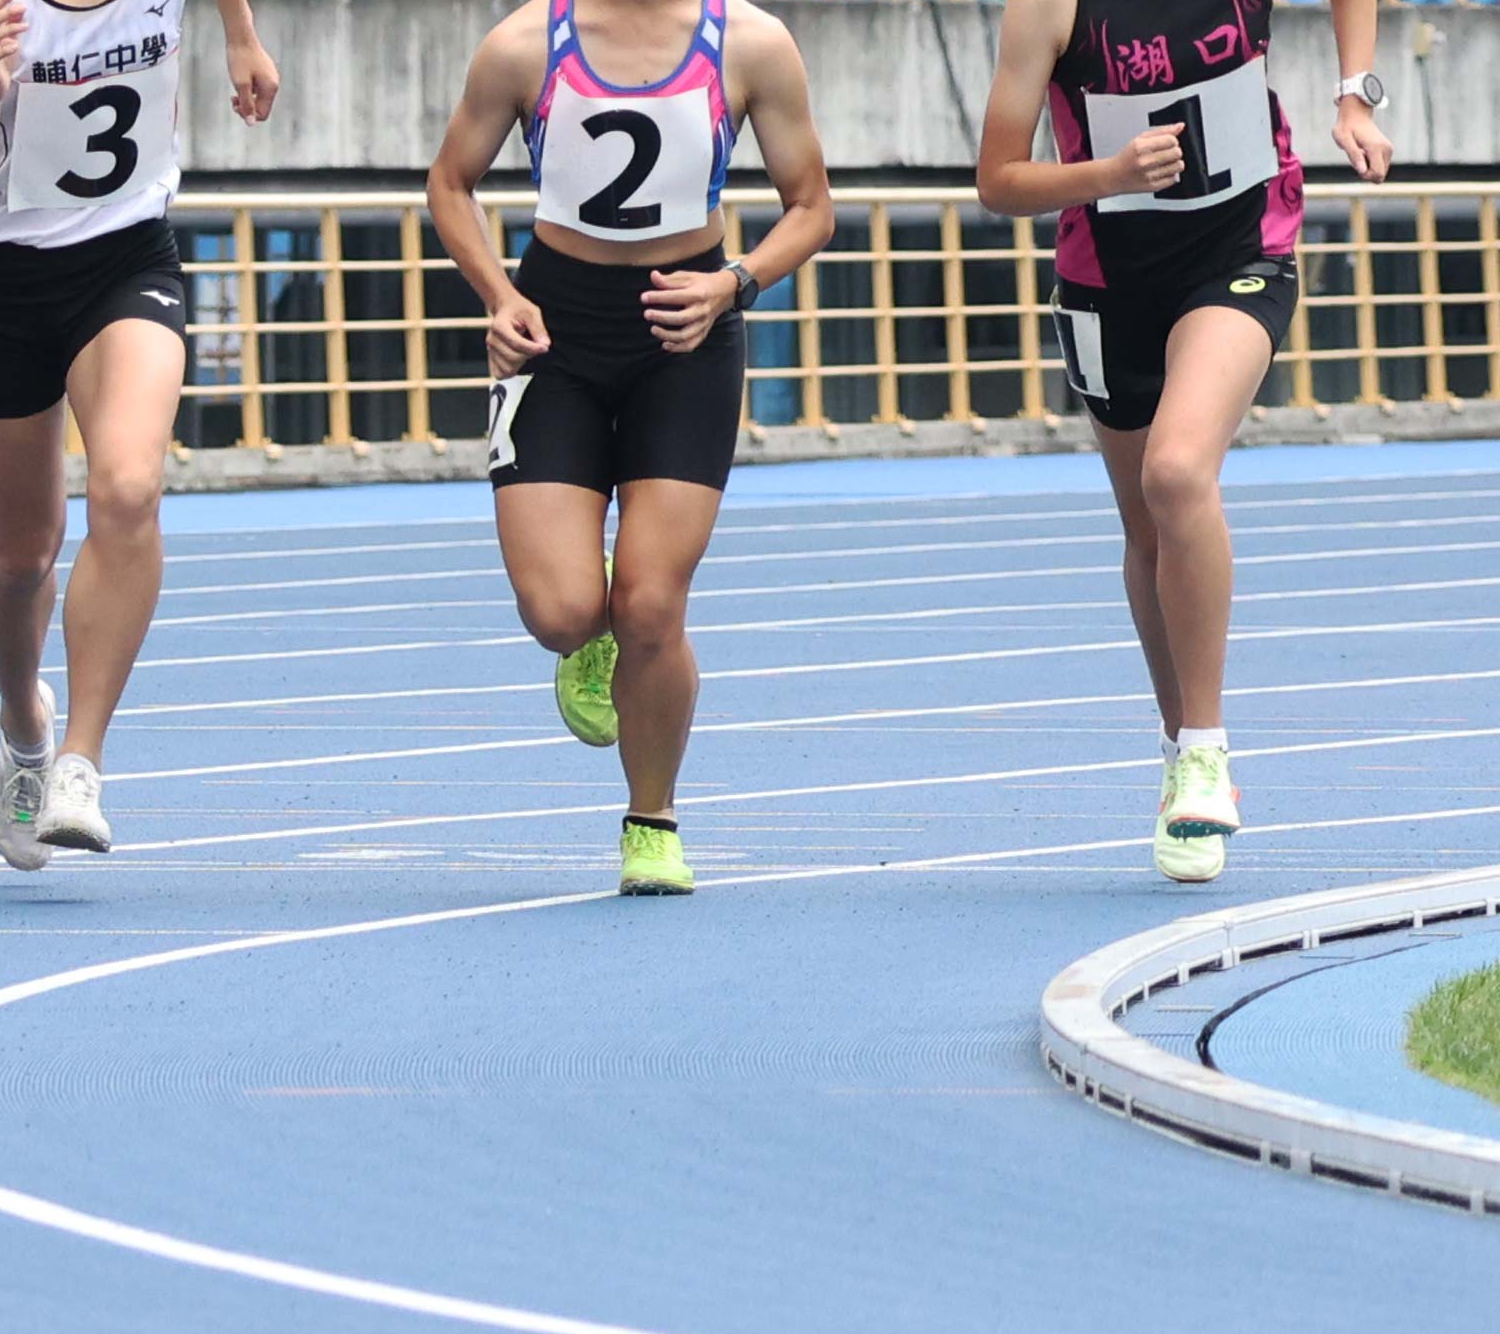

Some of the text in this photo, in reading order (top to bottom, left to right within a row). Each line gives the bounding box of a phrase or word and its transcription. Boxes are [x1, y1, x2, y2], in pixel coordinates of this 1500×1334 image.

[32, 32, 168, 84] 輔仁中學
[1117, 24, 1239, 93] 湖口
[55, 84, 142, 199] 3
[578, 109, 663, 229] 2
[1148, 94, 1232, 200] 1
